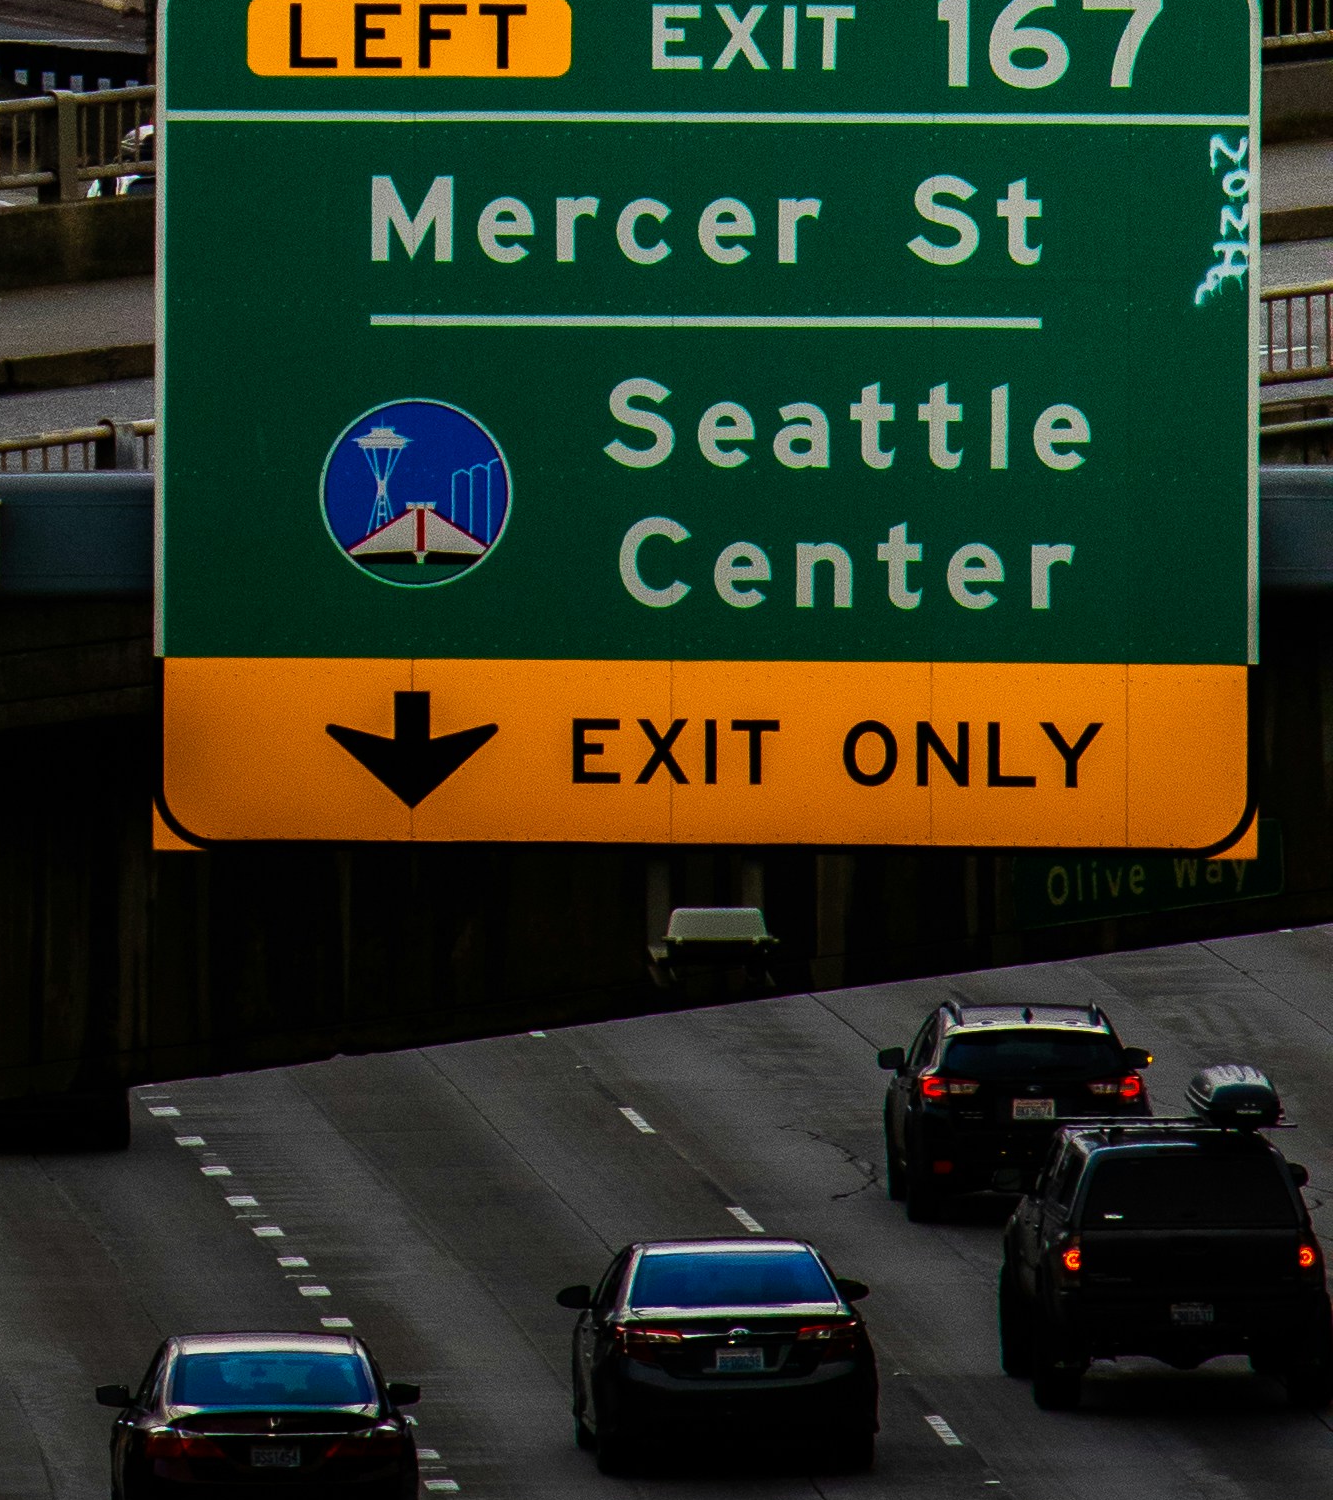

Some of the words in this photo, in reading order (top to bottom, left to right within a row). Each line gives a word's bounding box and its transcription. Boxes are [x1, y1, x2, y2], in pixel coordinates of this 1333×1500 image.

[290, 3, 527, 69] LEFT
[651, 5, 855, 70] EXIT
[370, 175, 822, 265] Mercer
[907, 174, 1043, 266] St
[603, 377, 1092, 471] Seattle
[618, 516, 1076, 610] Center
[571, 718, 780, 786] EXIT
[842, 719, 1103, 790] ONLY
[1046, 861, 1147, 906] Olive
[1173, 857, 1247, 893] Way
